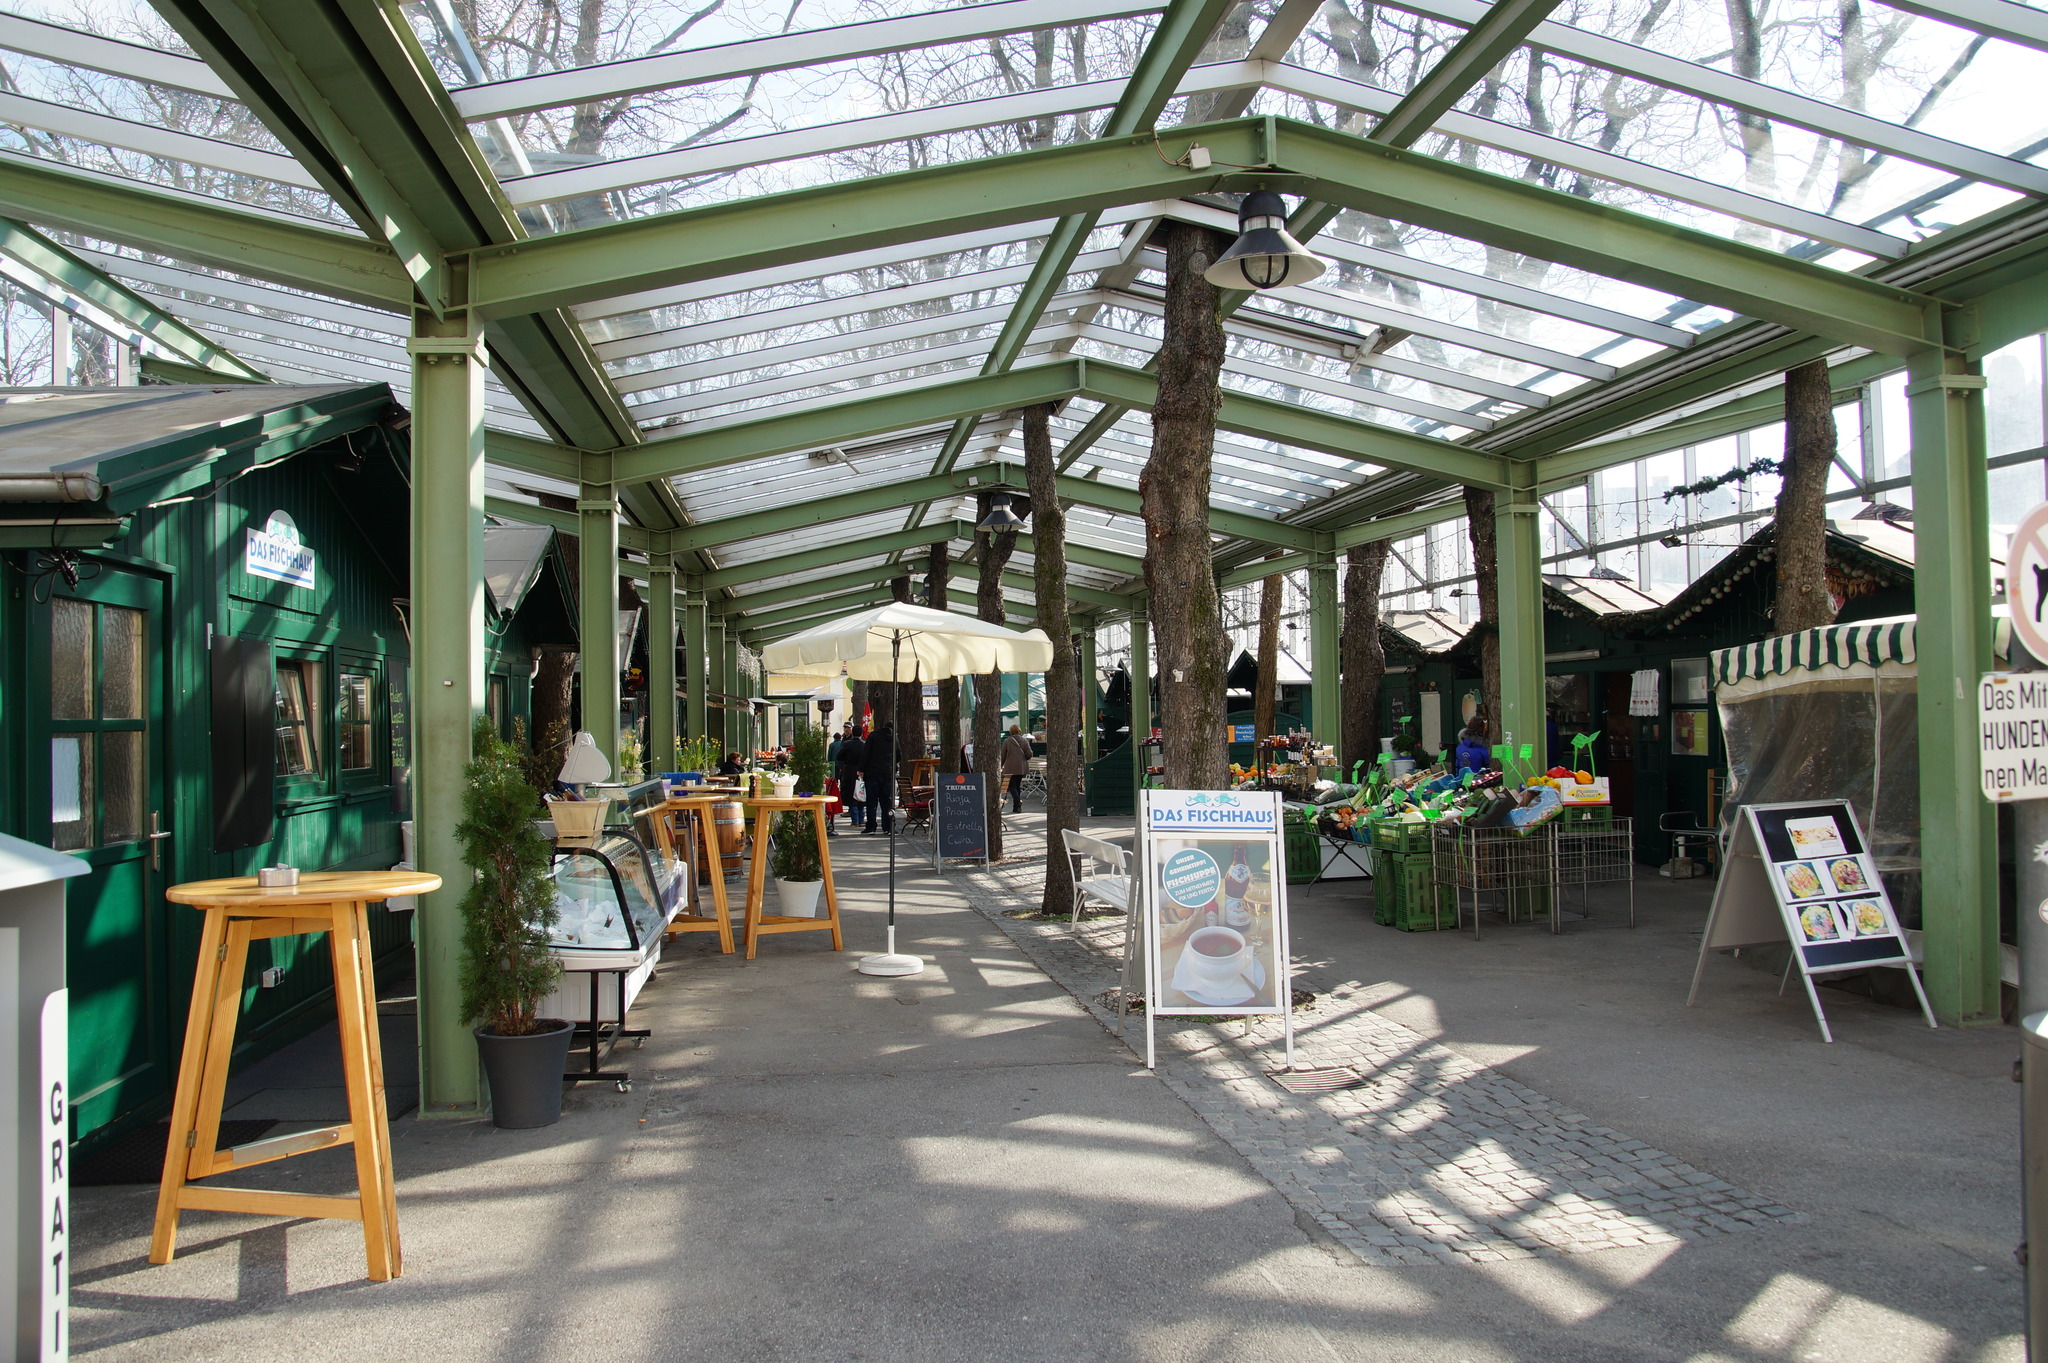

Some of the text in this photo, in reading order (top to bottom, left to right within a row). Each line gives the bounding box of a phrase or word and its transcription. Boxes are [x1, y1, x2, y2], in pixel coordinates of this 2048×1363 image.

[250, 537, 312, 572] DAS FISCHHAUS
[1983, 683, 2015, 711] Das
[1983, 719, 2048, 751] HUNDEN
[1985, 767, 2017, 789] nen
[946, 793, 971, 805] Rioja
[1153, 809, 1273, 823] DAS FISCHHAUS
[1175, 855, 1195, 865] UNSER
[1166, 866, 1216, 888] FISCHSUPPE
[1186, 879, 1215, 892] MITNEHMEN
[50, 1081, 64, 1354] GRATI
